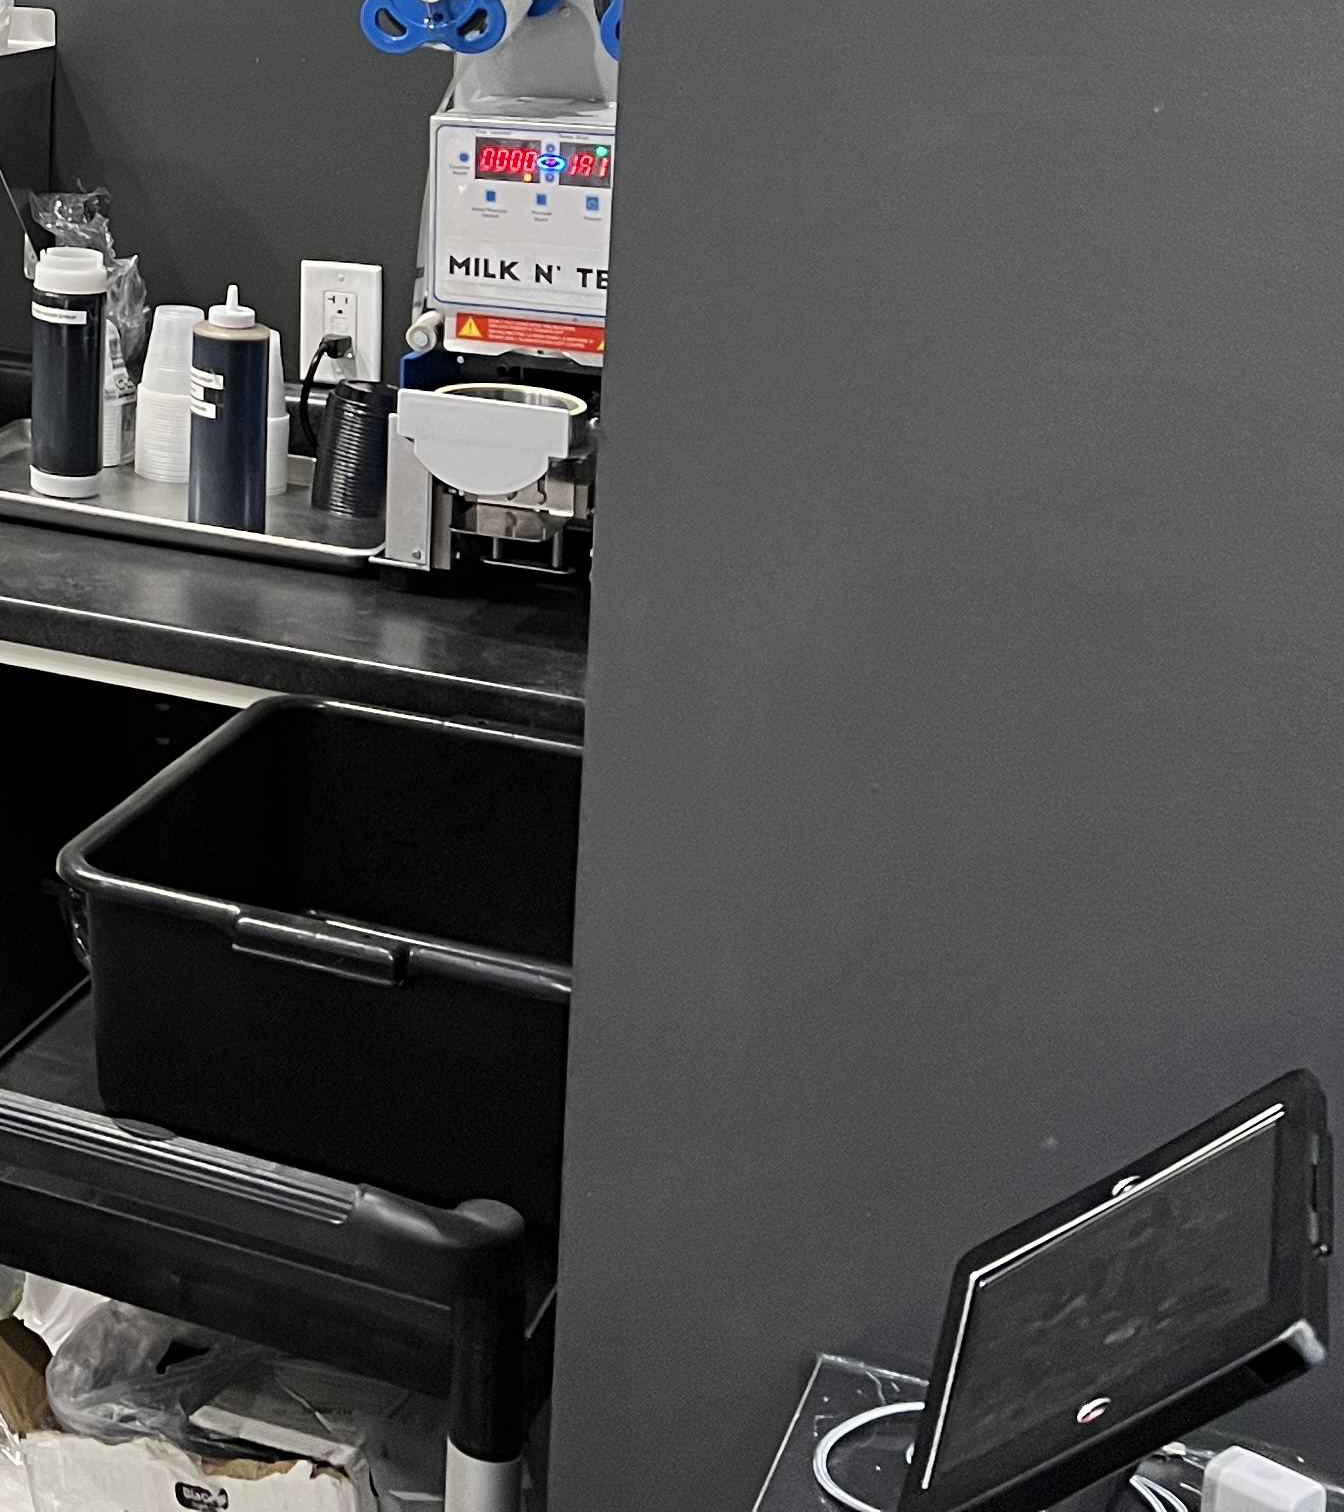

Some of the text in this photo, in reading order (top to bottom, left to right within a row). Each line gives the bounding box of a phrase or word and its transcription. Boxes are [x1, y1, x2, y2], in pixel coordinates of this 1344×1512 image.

[450, 255, 609, 290] MILK N' TE
